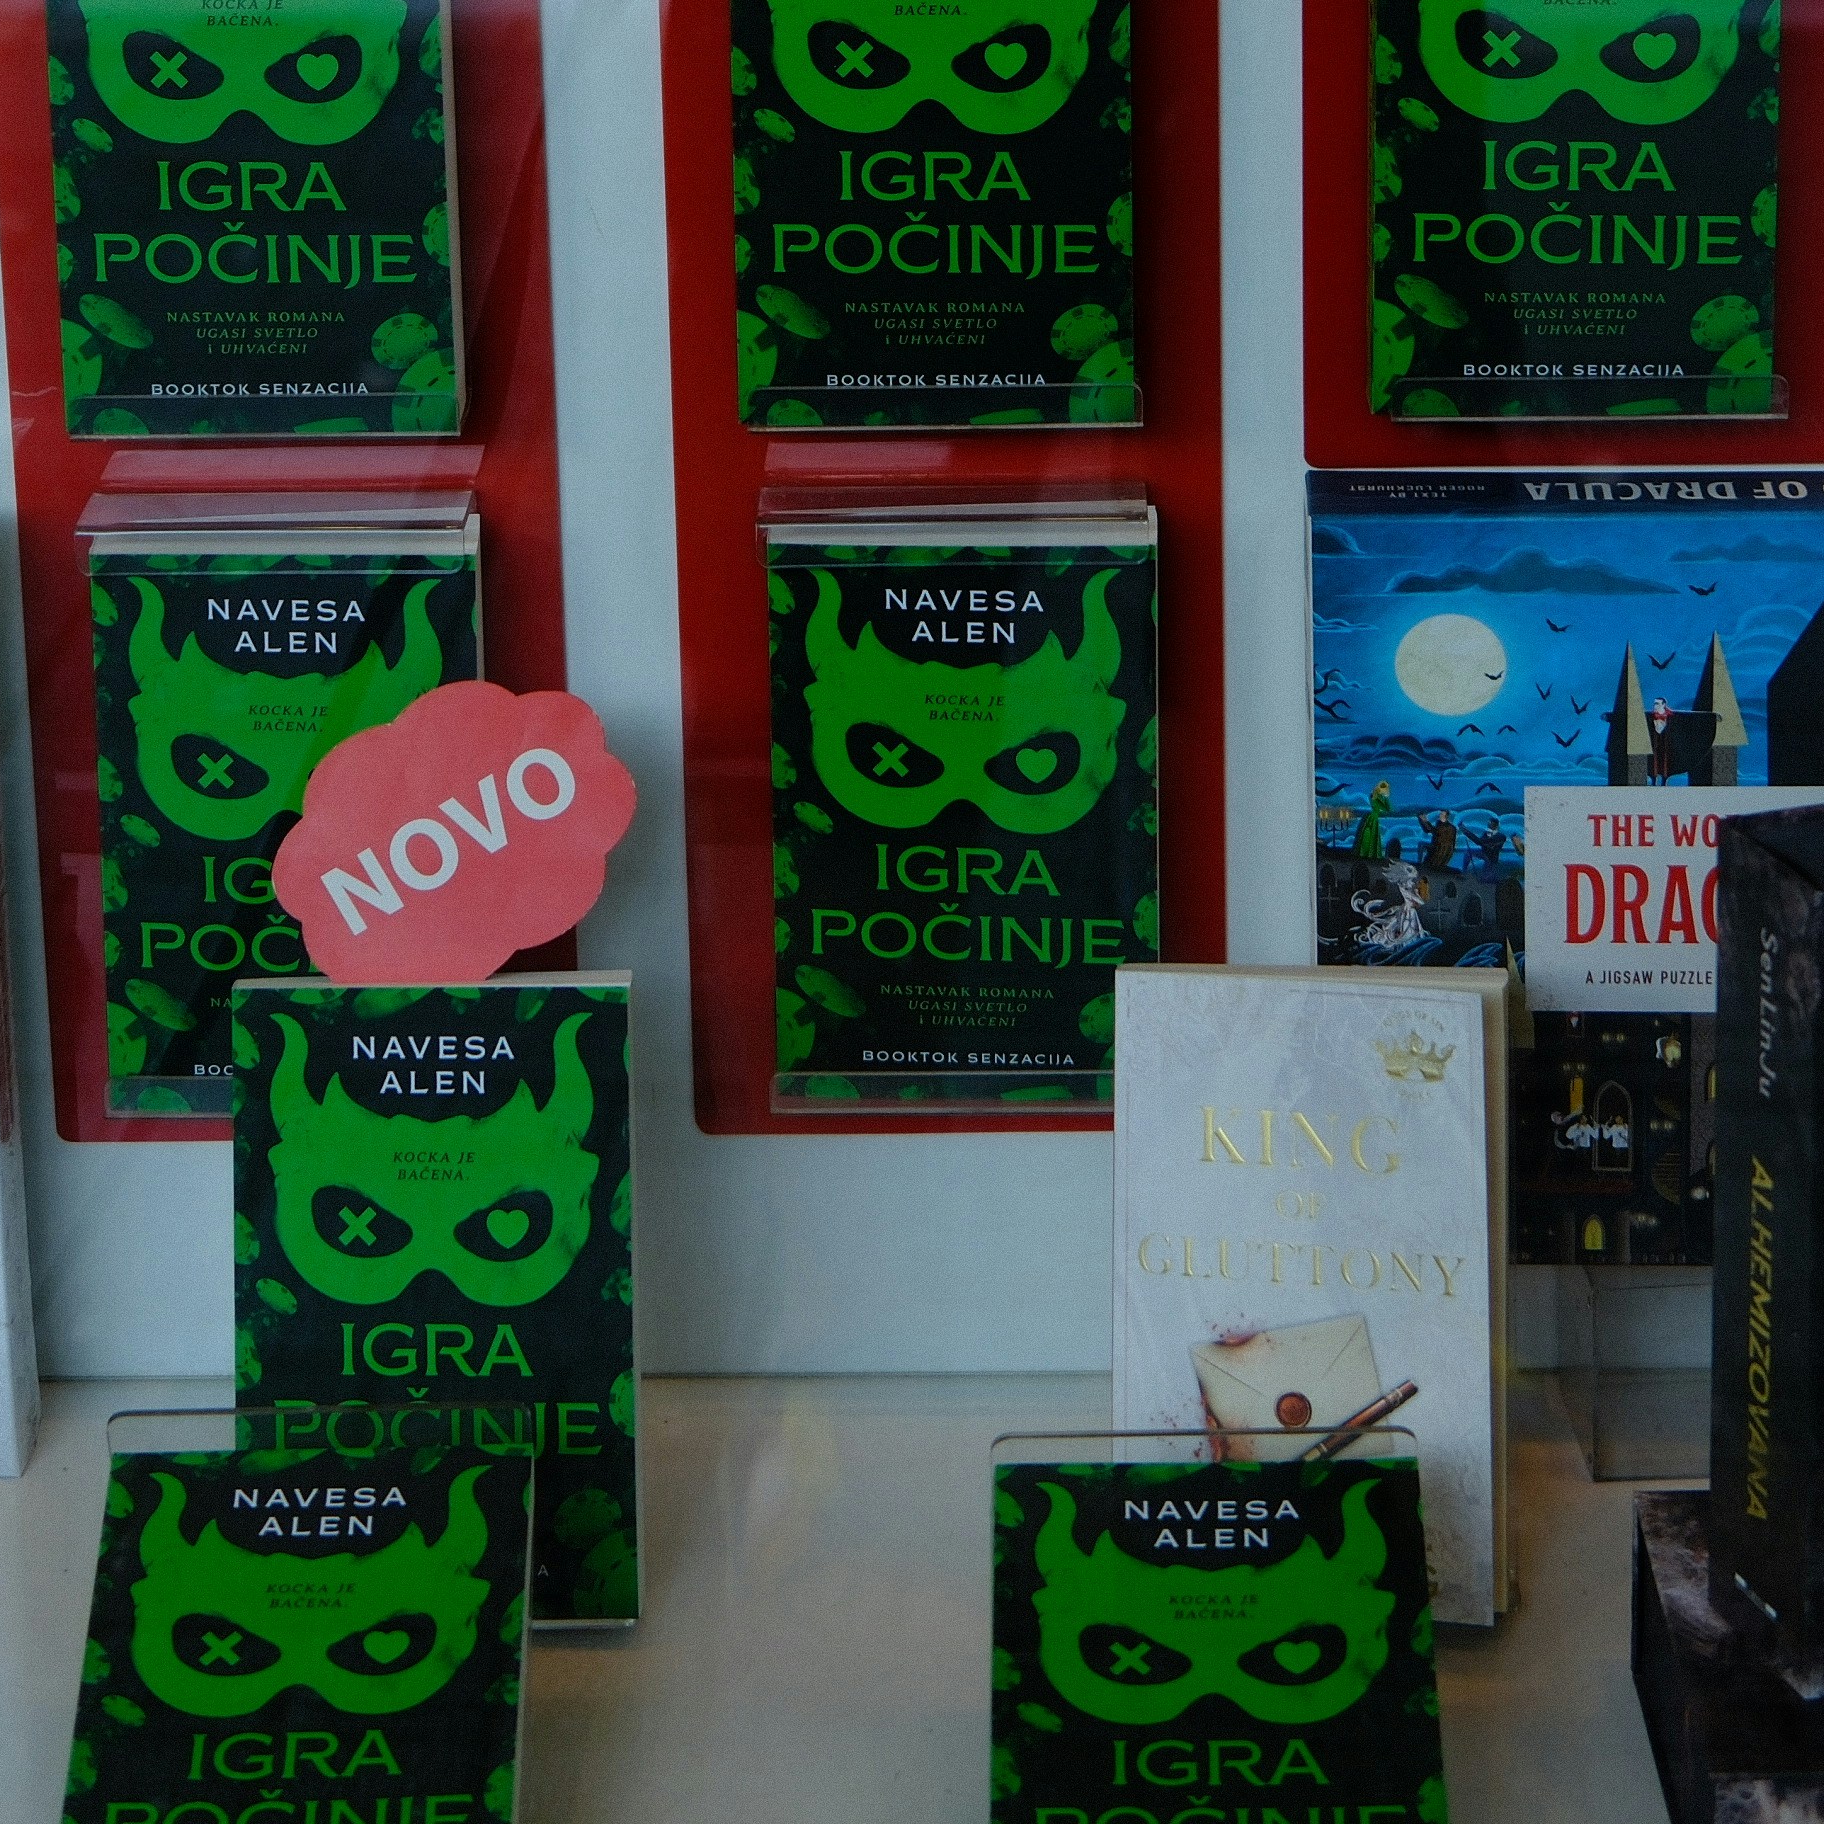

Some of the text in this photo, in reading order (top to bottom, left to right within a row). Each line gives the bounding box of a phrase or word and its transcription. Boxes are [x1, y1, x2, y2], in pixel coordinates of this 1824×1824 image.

[845, 302, 1025, 314] NASTAVAK ROMANA
[1464, 365, 1562, 376] BOOKTOK
[1525, 481, 1738, 500] DRACULA
[1754, 478, 1810, 500] OF
[320, 748, 576, 936] NOVO
[1588, 816, 1654, 846] THE
[1586, 970, 1712, 986] A JIGSAW PUZZLE
[1200, 1108, 1402, 1174] KING
[1137, 1234, 1464, 1298] GLUTTONY
